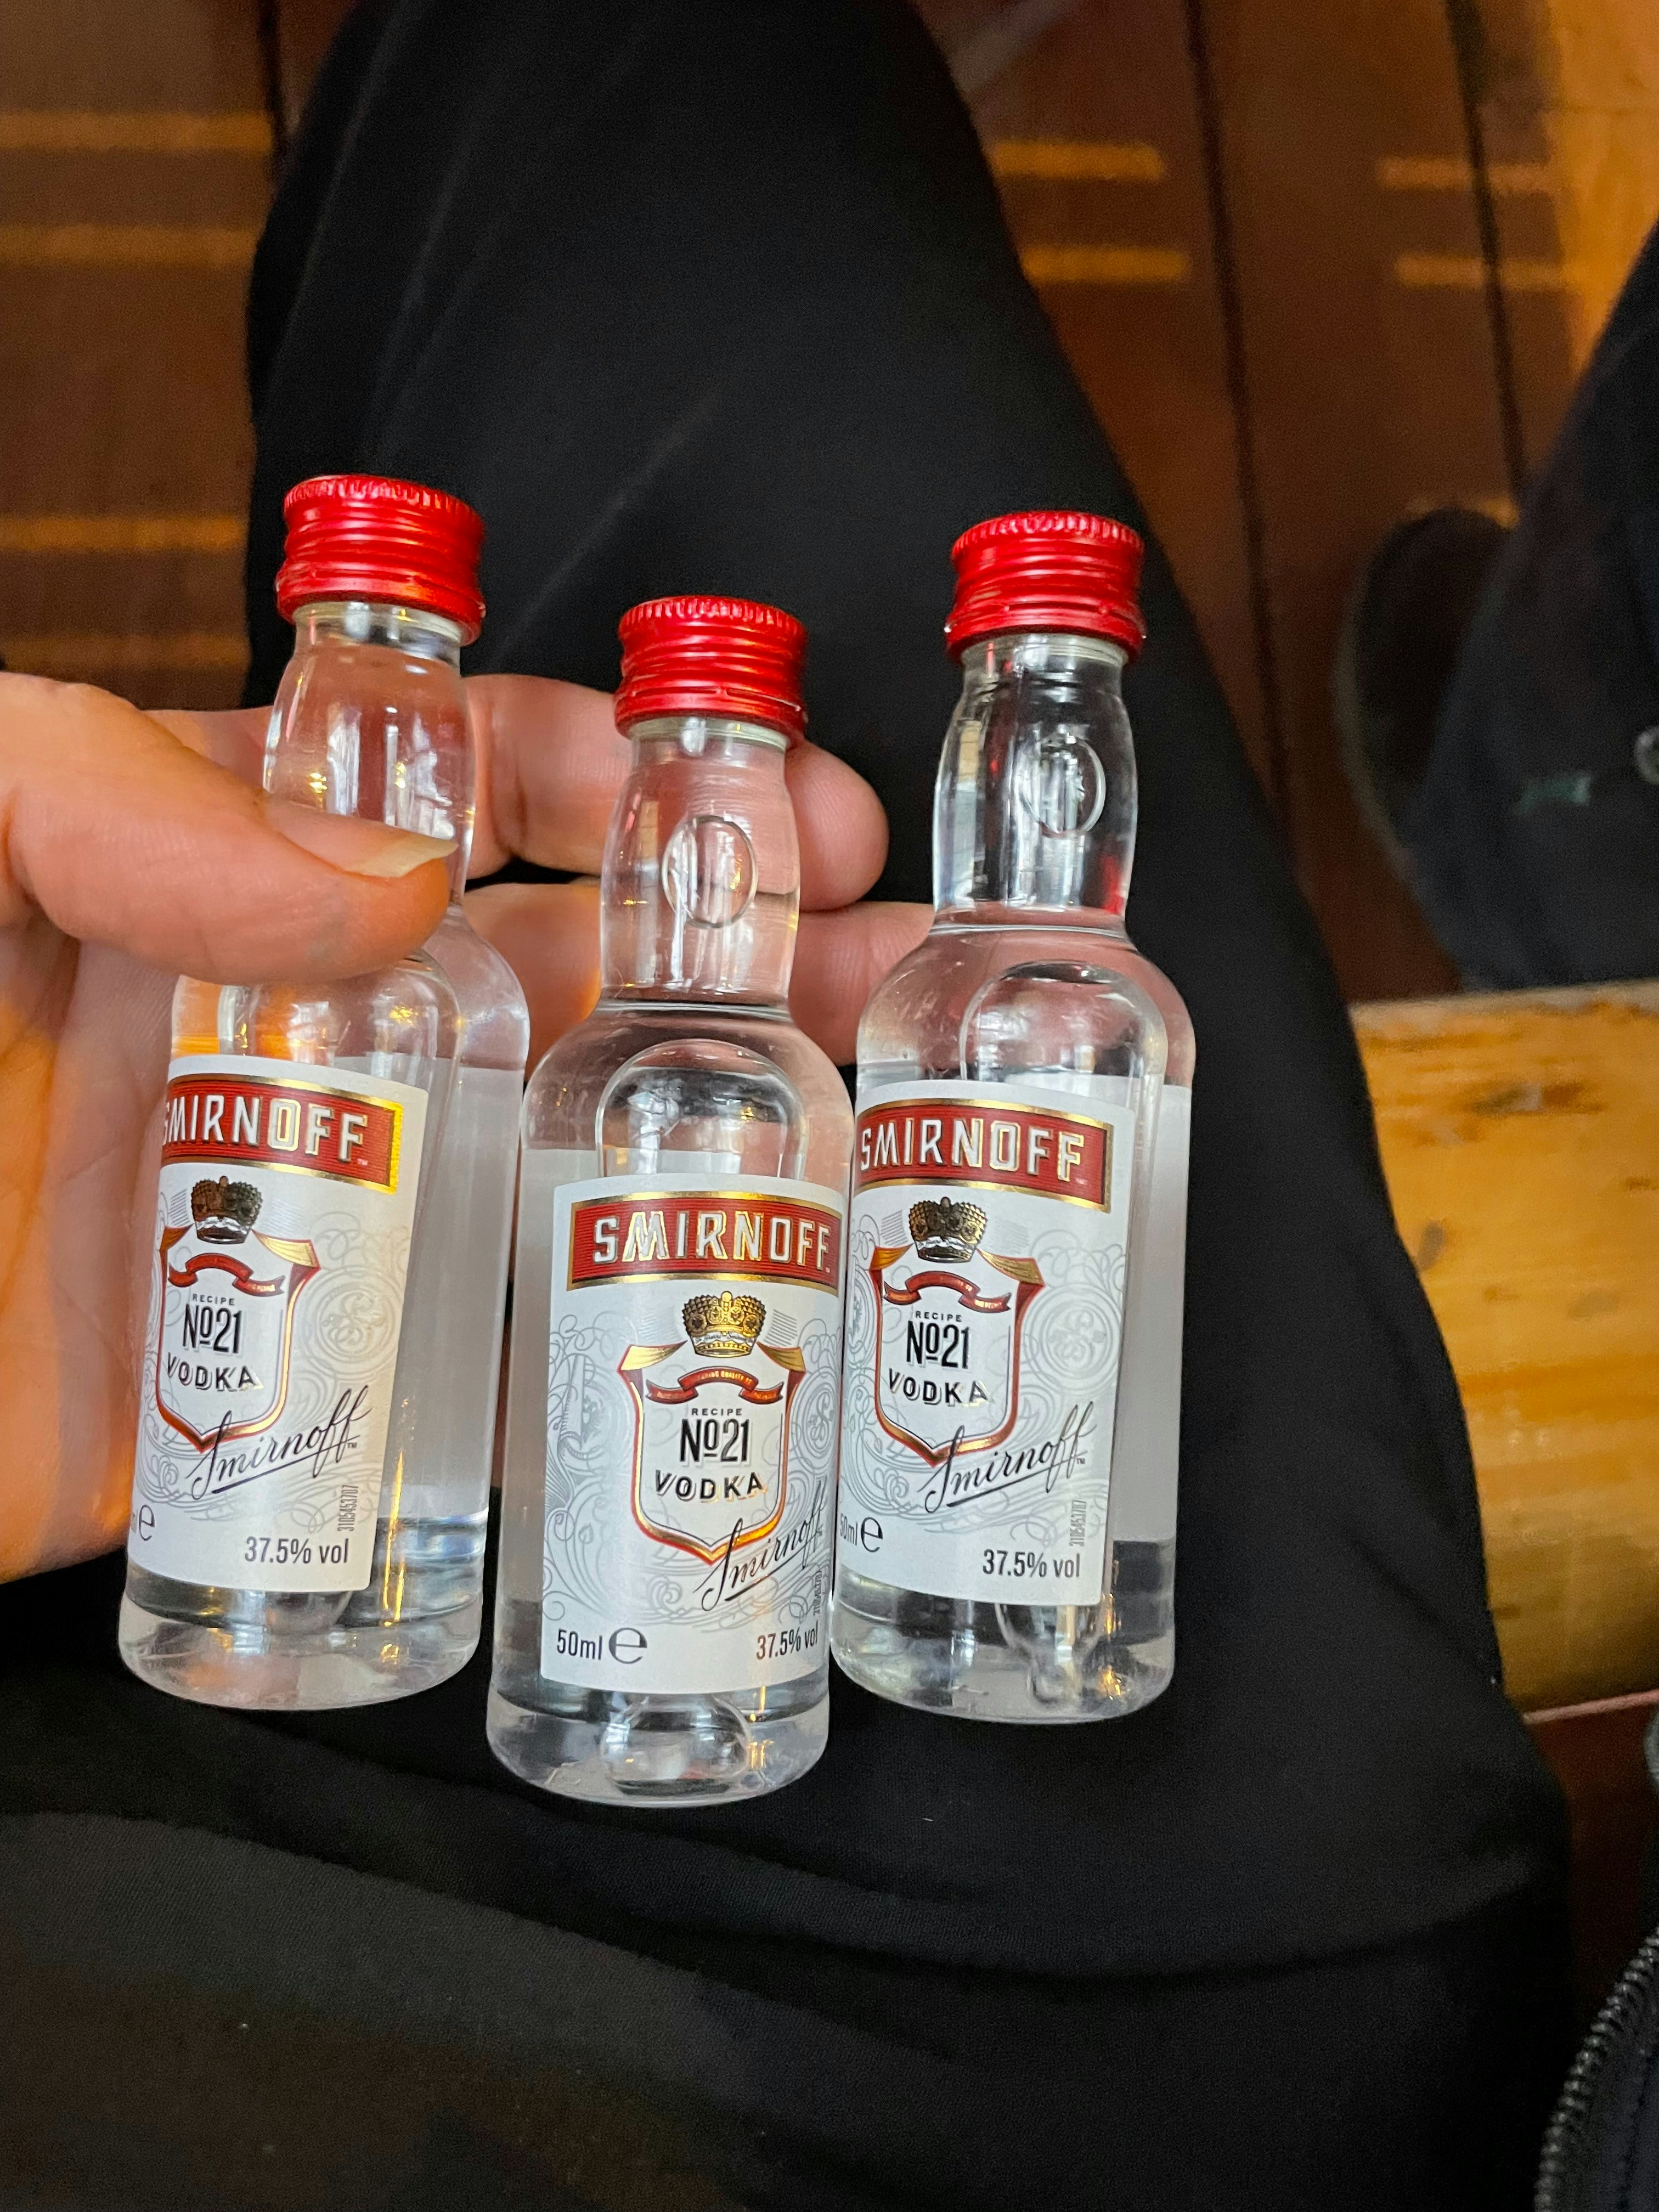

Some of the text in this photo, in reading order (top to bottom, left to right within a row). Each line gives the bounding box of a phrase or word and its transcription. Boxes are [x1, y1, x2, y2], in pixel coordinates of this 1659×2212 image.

[860, 1117, 1085, 1182] SMIRNOFF
[594, 1210, 830, 1271] SMIRNOFF
[192, 1293, 235, 1306] RECIPE
[915, 1310, 962, 1323] RECIPE
[167, 1351, 261, 1390] VODKA
[889, 1367, 991, 1405] VODKA
[691, 1408, 742, 1416] RECIPE
[185, 1385, 372, 1500] Smirnoff
[917, 1401, 1097, 1514] Smirnoff
[656, 1469, 766, 1501] VODKA
[245, 1536, 349, 1565] 37.5% vol
[692, 1474, 828, 1612] Smirnoff
[983, 1549, 1080, 1578] 37.5% vol
[557, 1628, 603, 1661] 50ml
[756, 1620, 819, 1660] 37.5% vol
